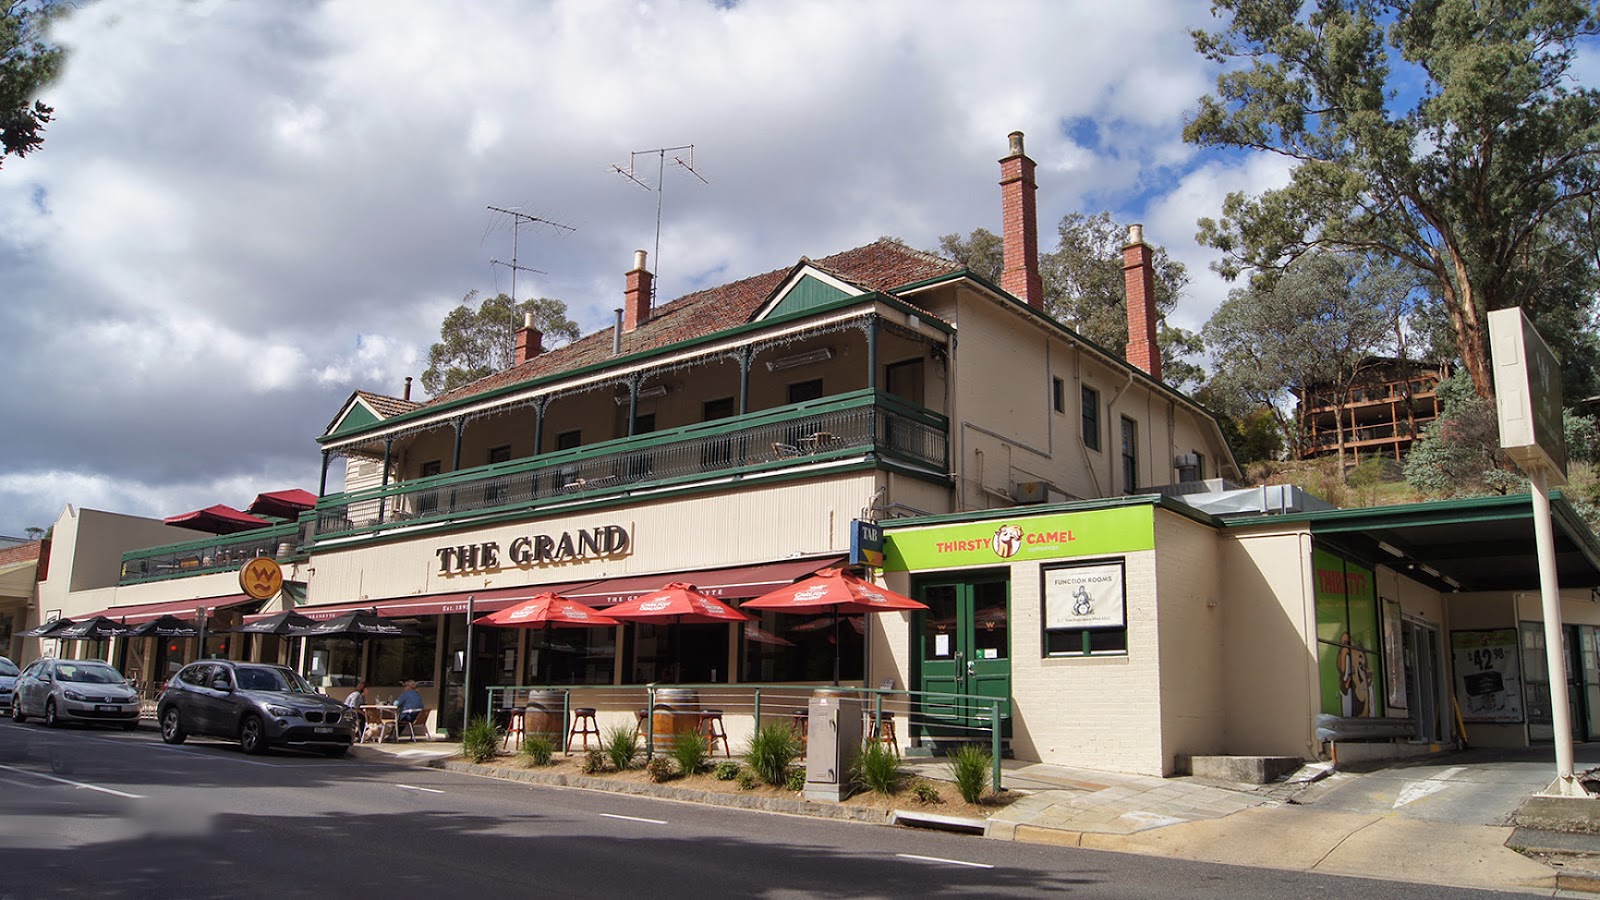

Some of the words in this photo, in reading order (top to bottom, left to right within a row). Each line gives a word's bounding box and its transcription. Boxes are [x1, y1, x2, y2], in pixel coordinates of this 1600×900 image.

[862, 526, 878, 541] TAB
[936, 537, 991, 553] THIRSTY
[1026, 530, 1076, 545] CAMEL
[436, 542, 499, 572] THE
[509, 525, 629, 565] GRAND
[252, 565, 276, 582] W
